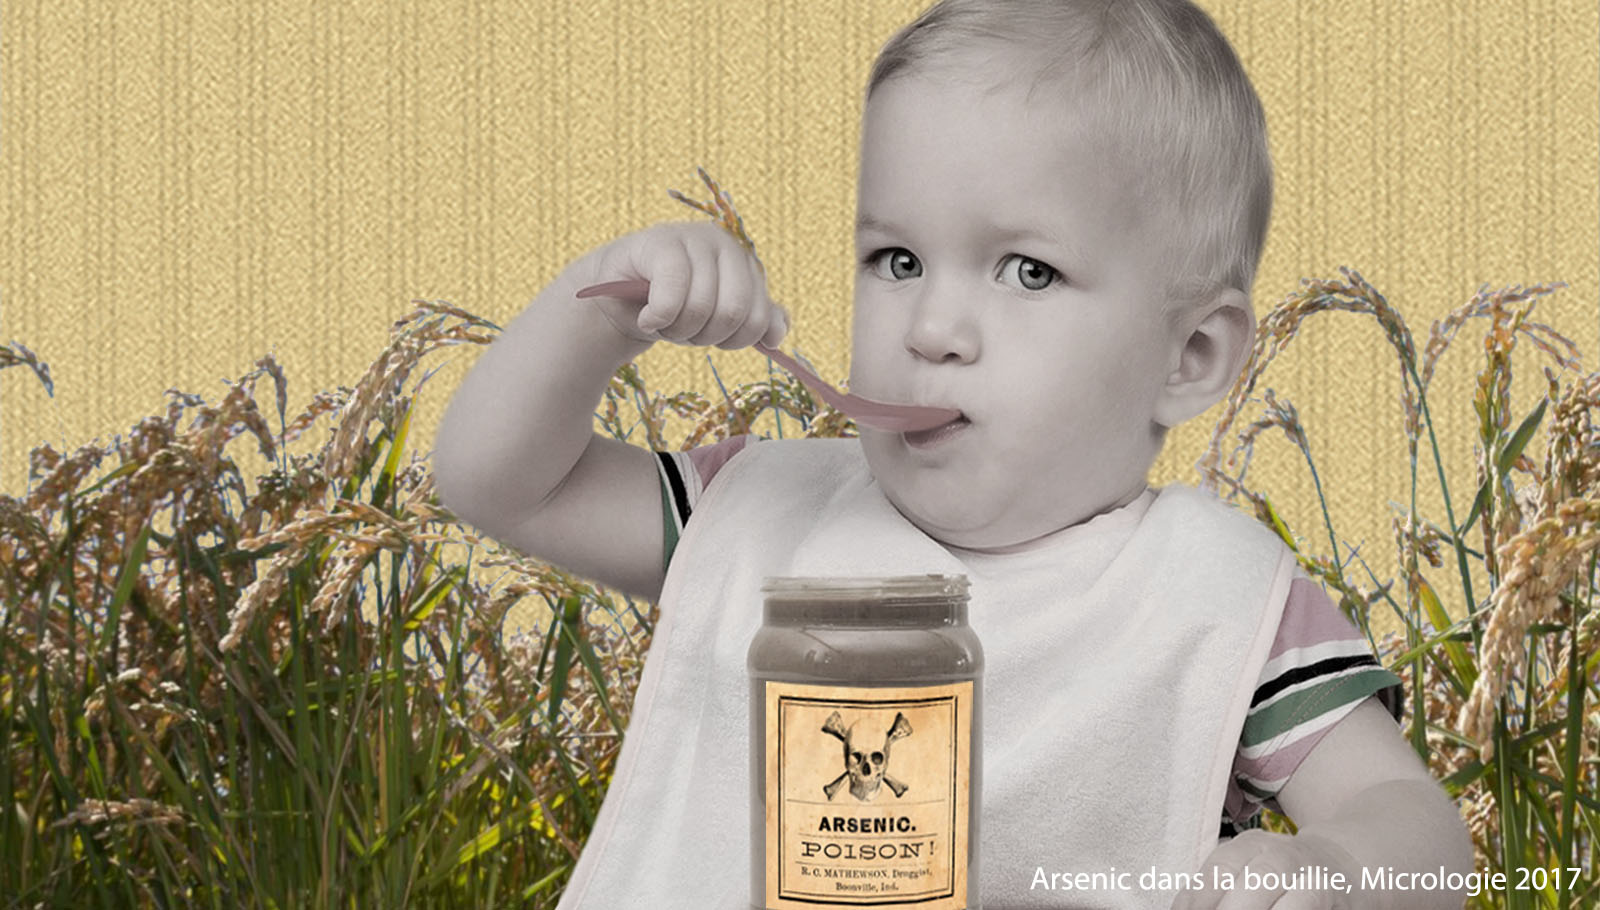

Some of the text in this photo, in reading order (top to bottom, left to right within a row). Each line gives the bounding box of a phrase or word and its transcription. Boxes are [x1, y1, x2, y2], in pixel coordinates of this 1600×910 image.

[818, 816, 917, 833] ARSENIC.
[801, 866, 811, 876] R.
[813, 868, 822, 877] C.
